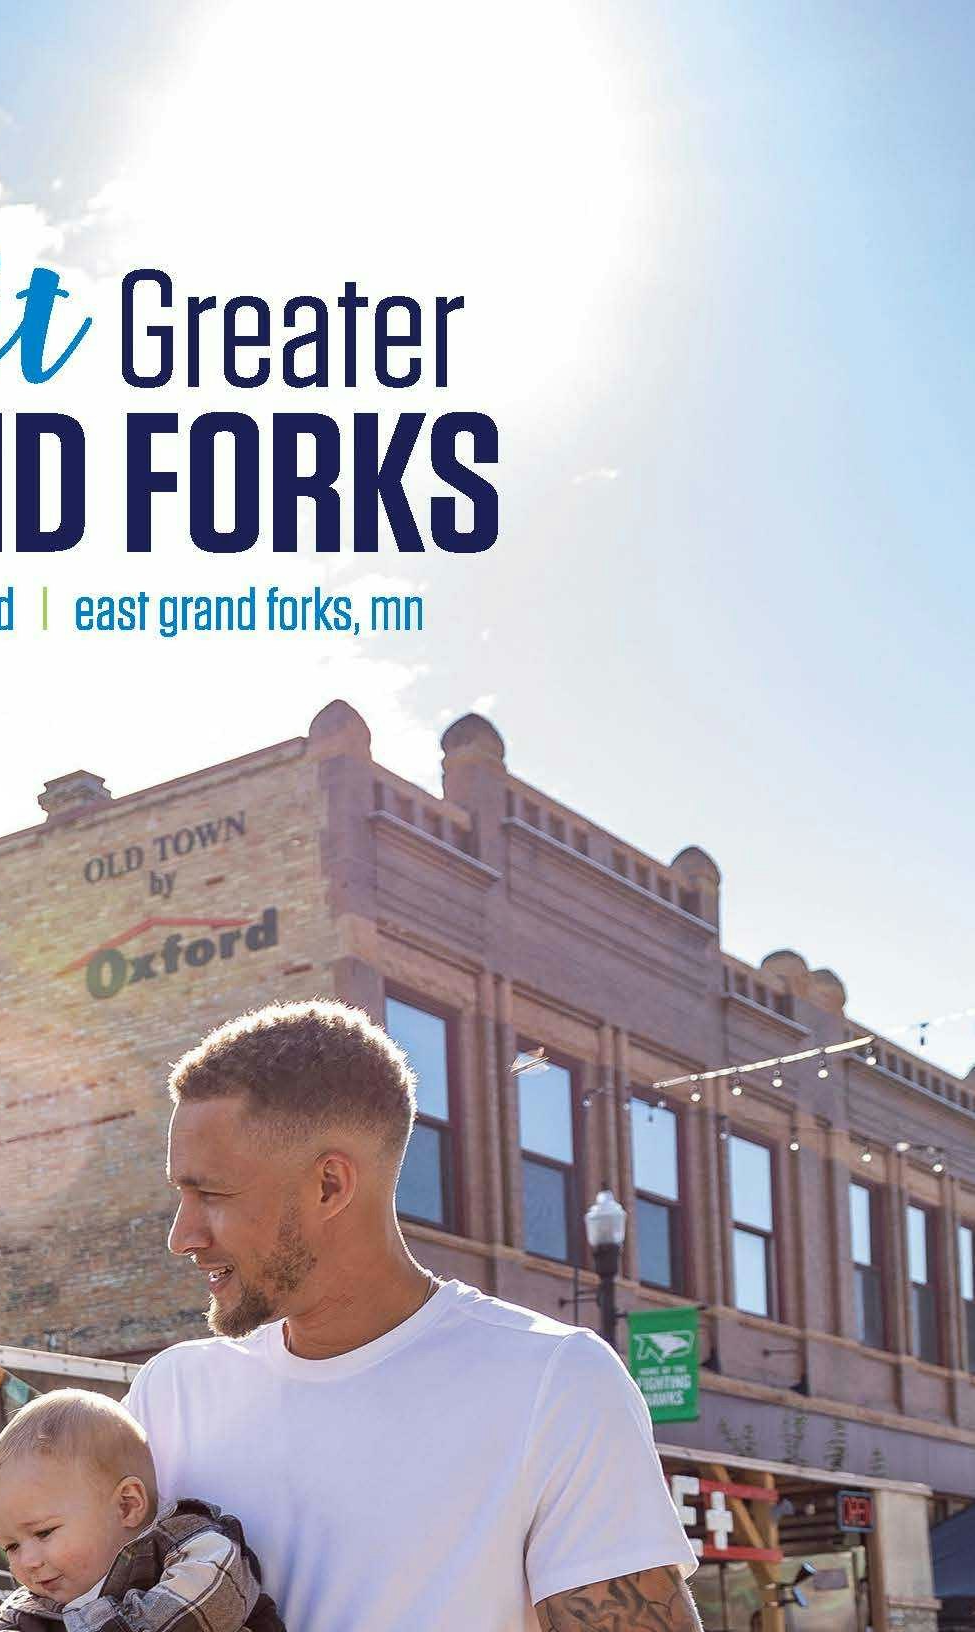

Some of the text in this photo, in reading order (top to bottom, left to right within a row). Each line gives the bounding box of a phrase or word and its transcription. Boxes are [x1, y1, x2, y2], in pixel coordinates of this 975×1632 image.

[83, 810, 247, 884] OLD TOWN
[148, 870, 176, 898] by
[86, 906, 279, 999] Oxford
